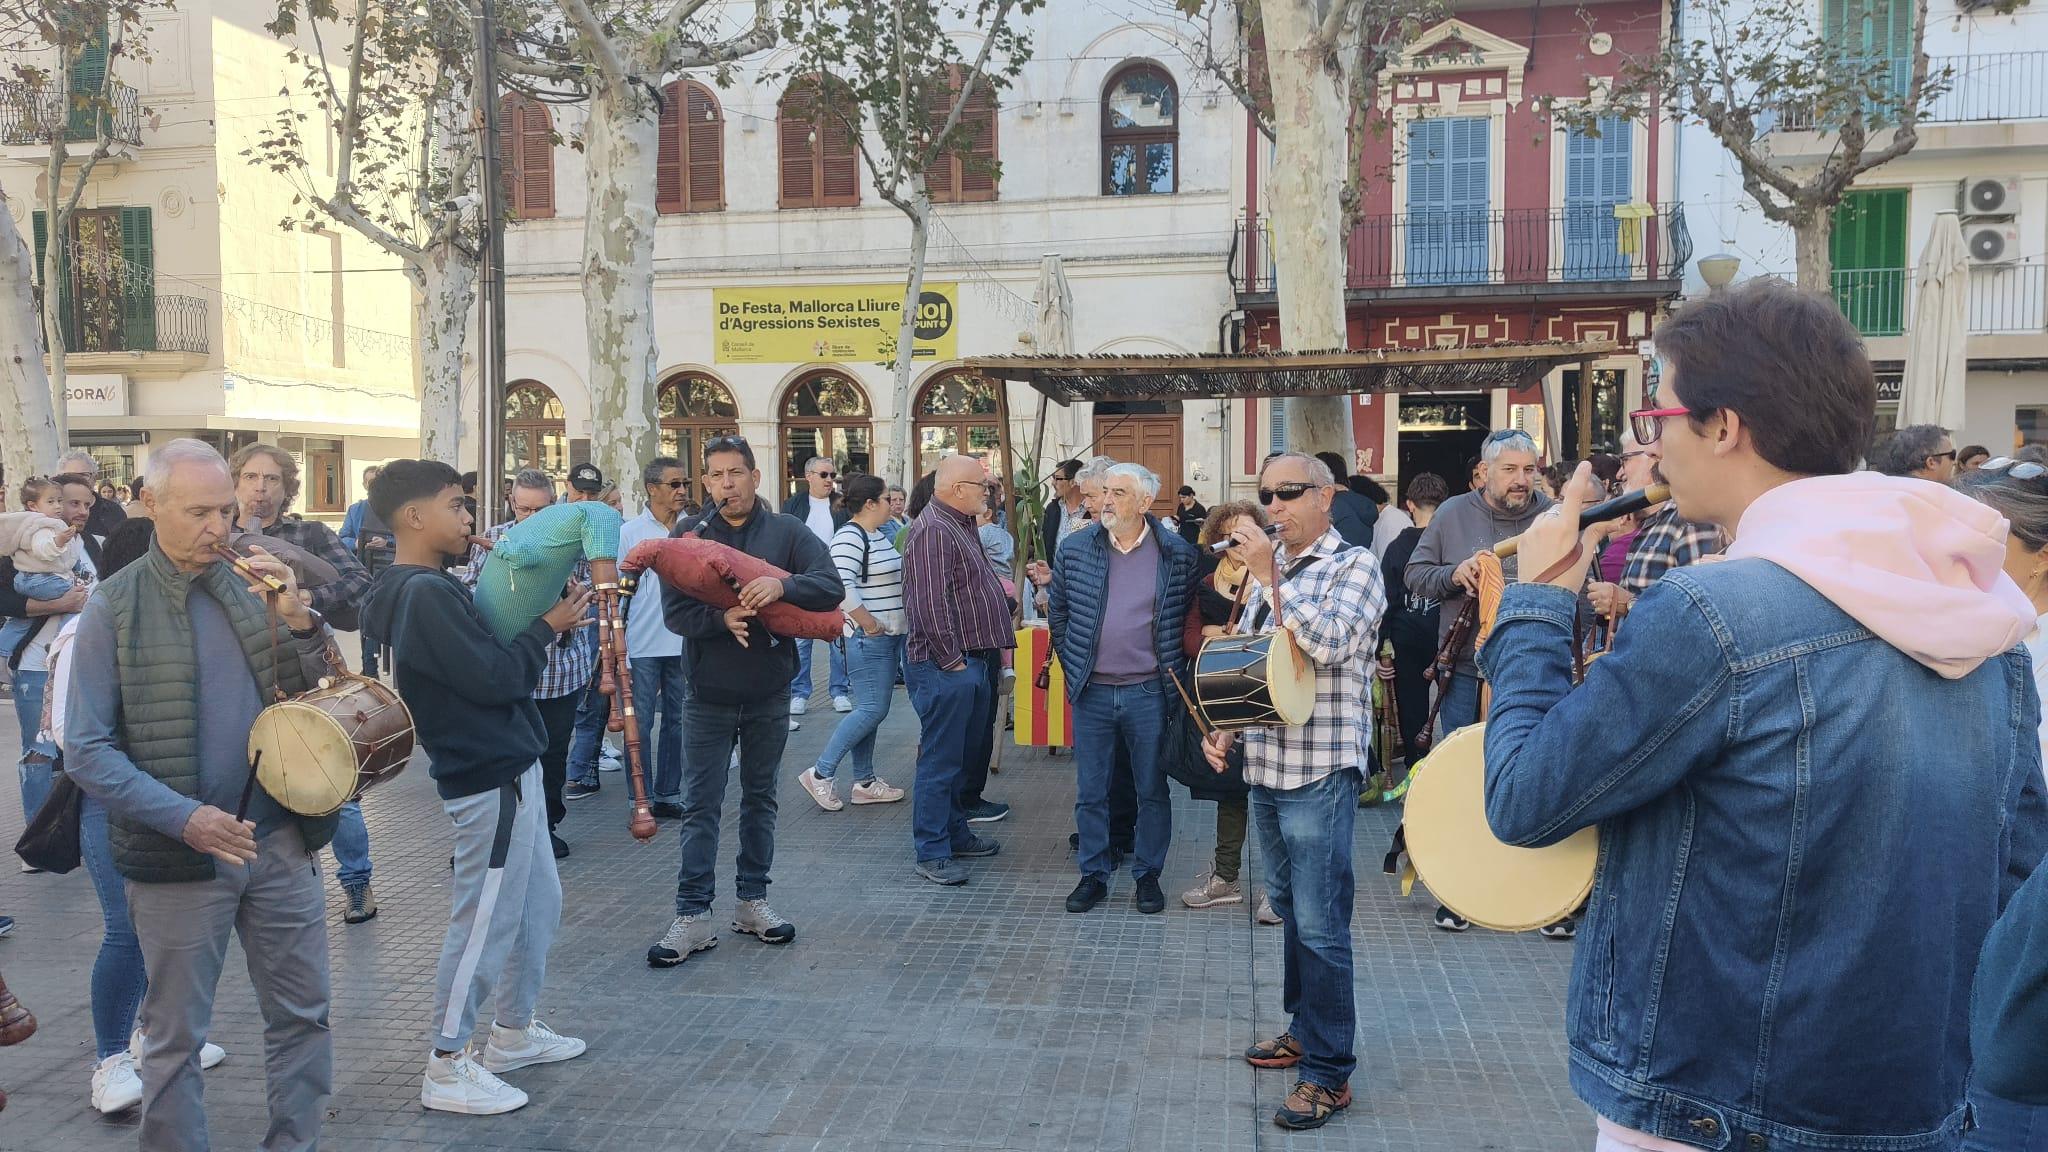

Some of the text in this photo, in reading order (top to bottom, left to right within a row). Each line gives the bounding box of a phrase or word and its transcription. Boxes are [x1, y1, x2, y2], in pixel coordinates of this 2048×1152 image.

[720, 299, 900, 314] De Festa, Mallorca Lliure
[817, 316, 880, 328] Sexistes
